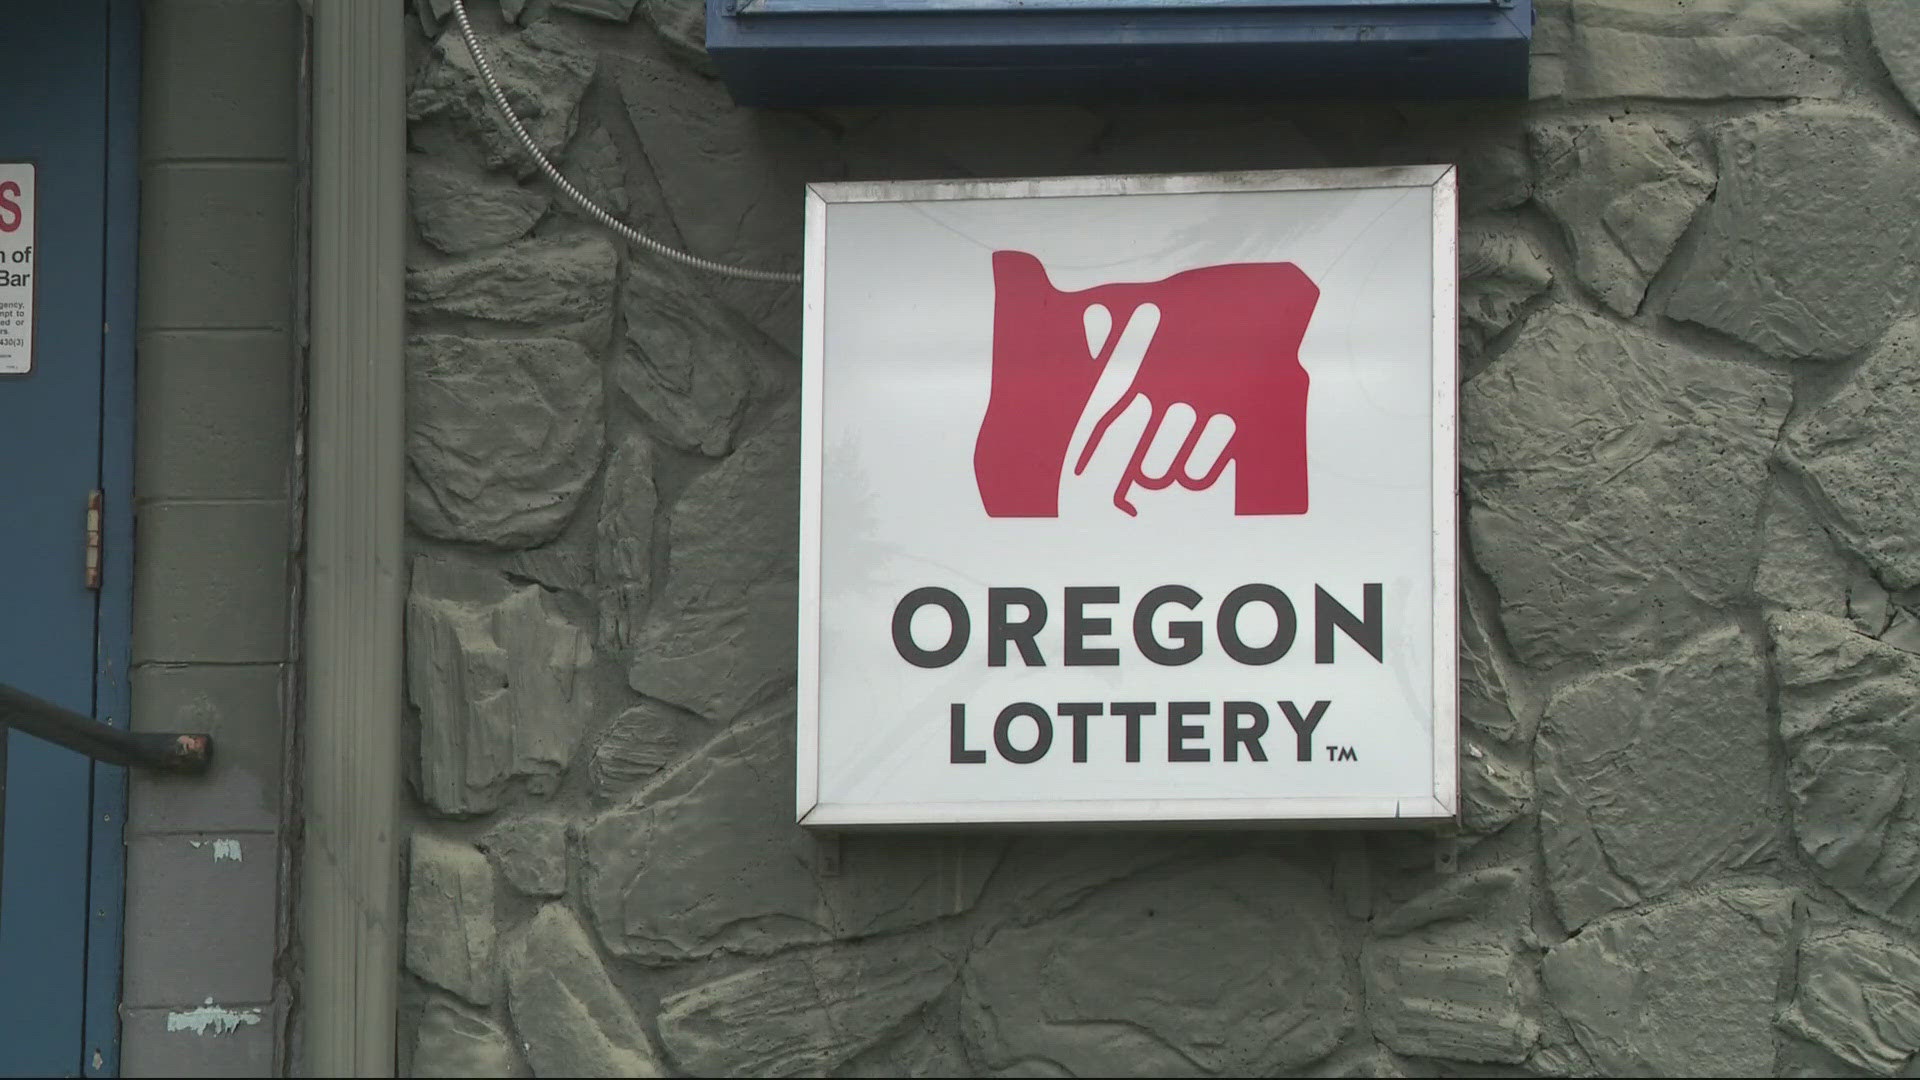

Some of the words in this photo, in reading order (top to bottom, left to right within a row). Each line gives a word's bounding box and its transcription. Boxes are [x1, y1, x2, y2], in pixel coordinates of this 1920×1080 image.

[0, 181, 22, 233] S
[0, 270, 31, 287] Bar
[12, 245, 32, 263] of
[891, 582, 1383, 669] OREGON
[950, 700, 1332, 764] LOTTERY
